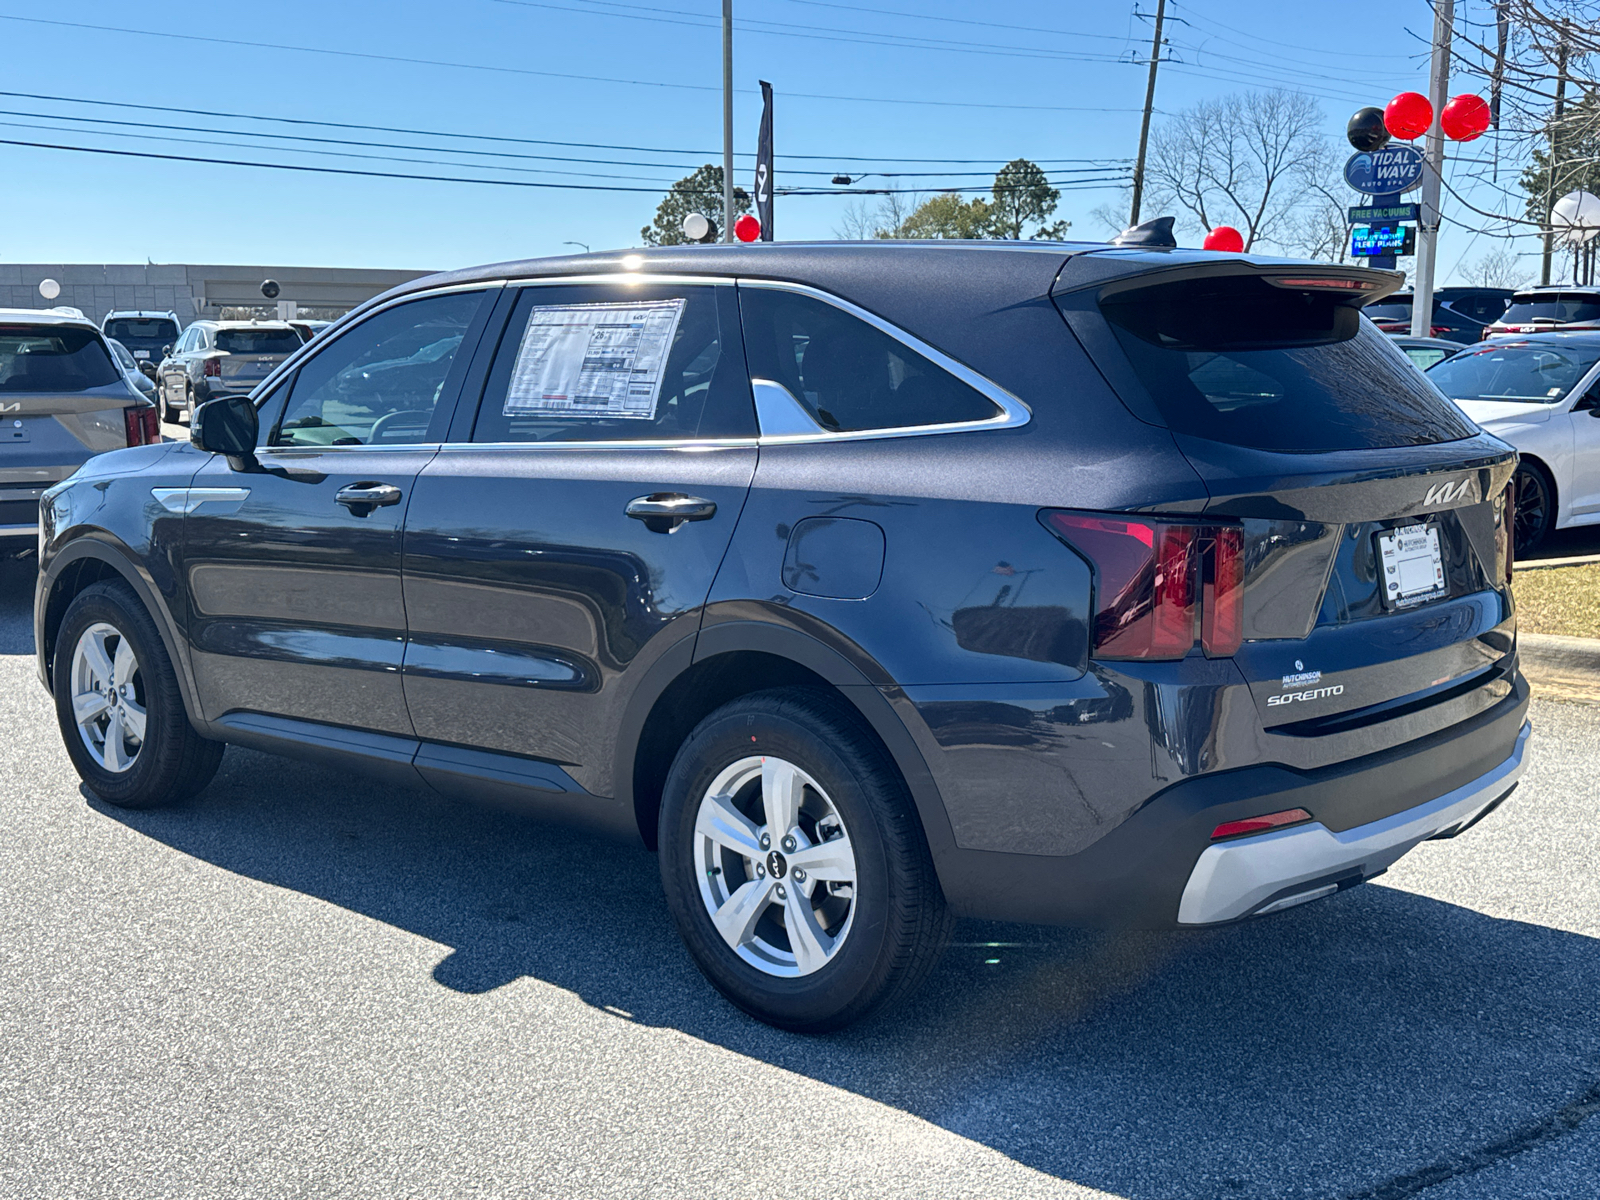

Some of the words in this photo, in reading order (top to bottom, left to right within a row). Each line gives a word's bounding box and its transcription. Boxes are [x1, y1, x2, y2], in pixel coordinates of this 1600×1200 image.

[1372, 151, 1409, 166] TIDAL
[1377, 164, 1417, 179] WAVE
[1351, 209, 1371, 219] FREE
[1373, 206, 1411, 217] VACUUMS
[1377, 239, 1403, 248] PLANS
[1282, 671, 1321, 684] HUTCHINSON
[1267, 684, 1344, 707] SORENTO
